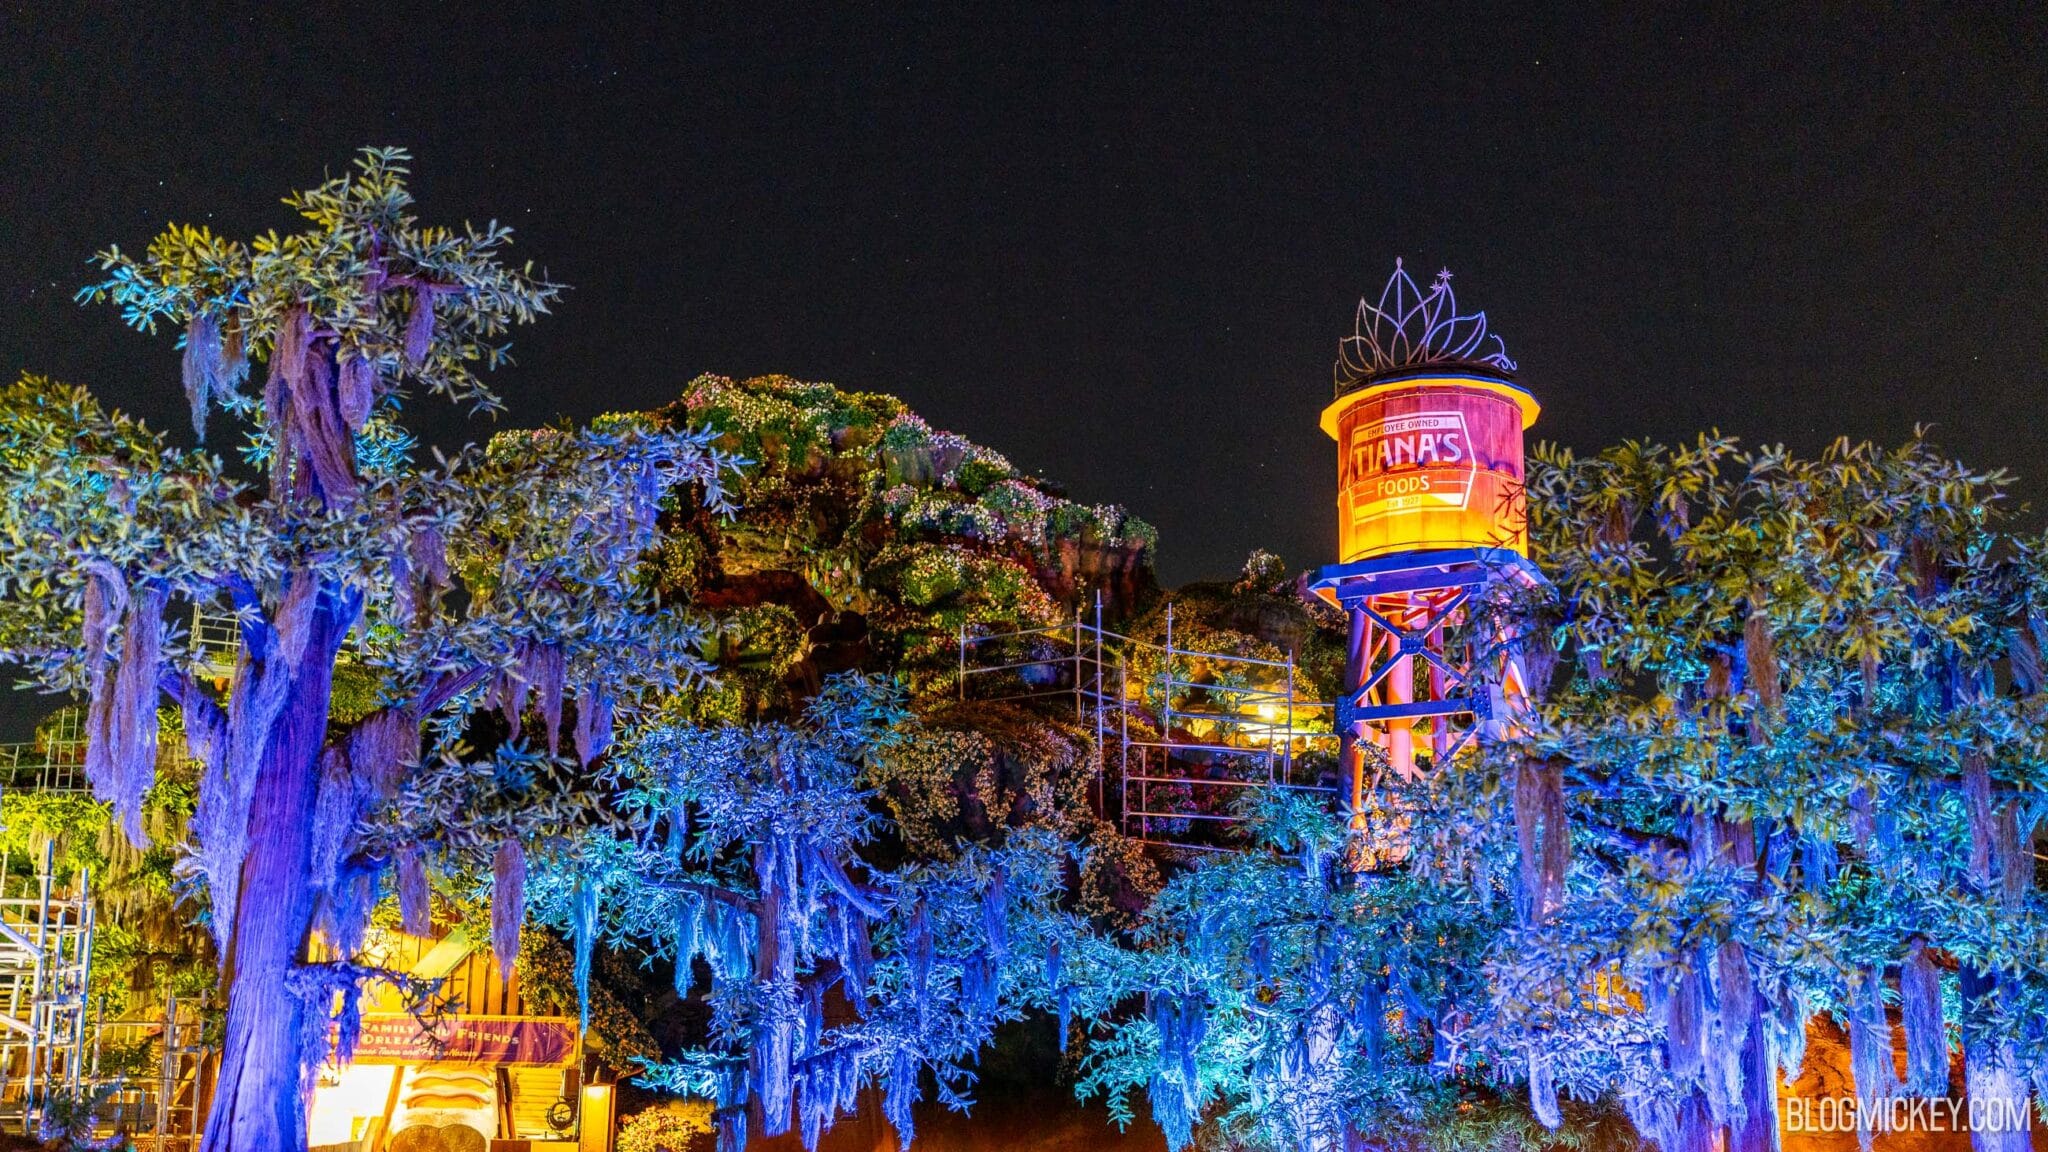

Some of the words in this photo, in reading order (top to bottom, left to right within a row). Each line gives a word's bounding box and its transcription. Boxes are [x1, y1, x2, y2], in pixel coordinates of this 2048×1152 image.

[1367, 422, 1406, 438] EMPLOYEE
[1407, 419, 1439, 431] OWNED
[1353, 433, 1462, 476] TIANA'S
[1377, 475, 1430, 496] FOODS
[456, 1028, 520, 1045] FRIENDS
